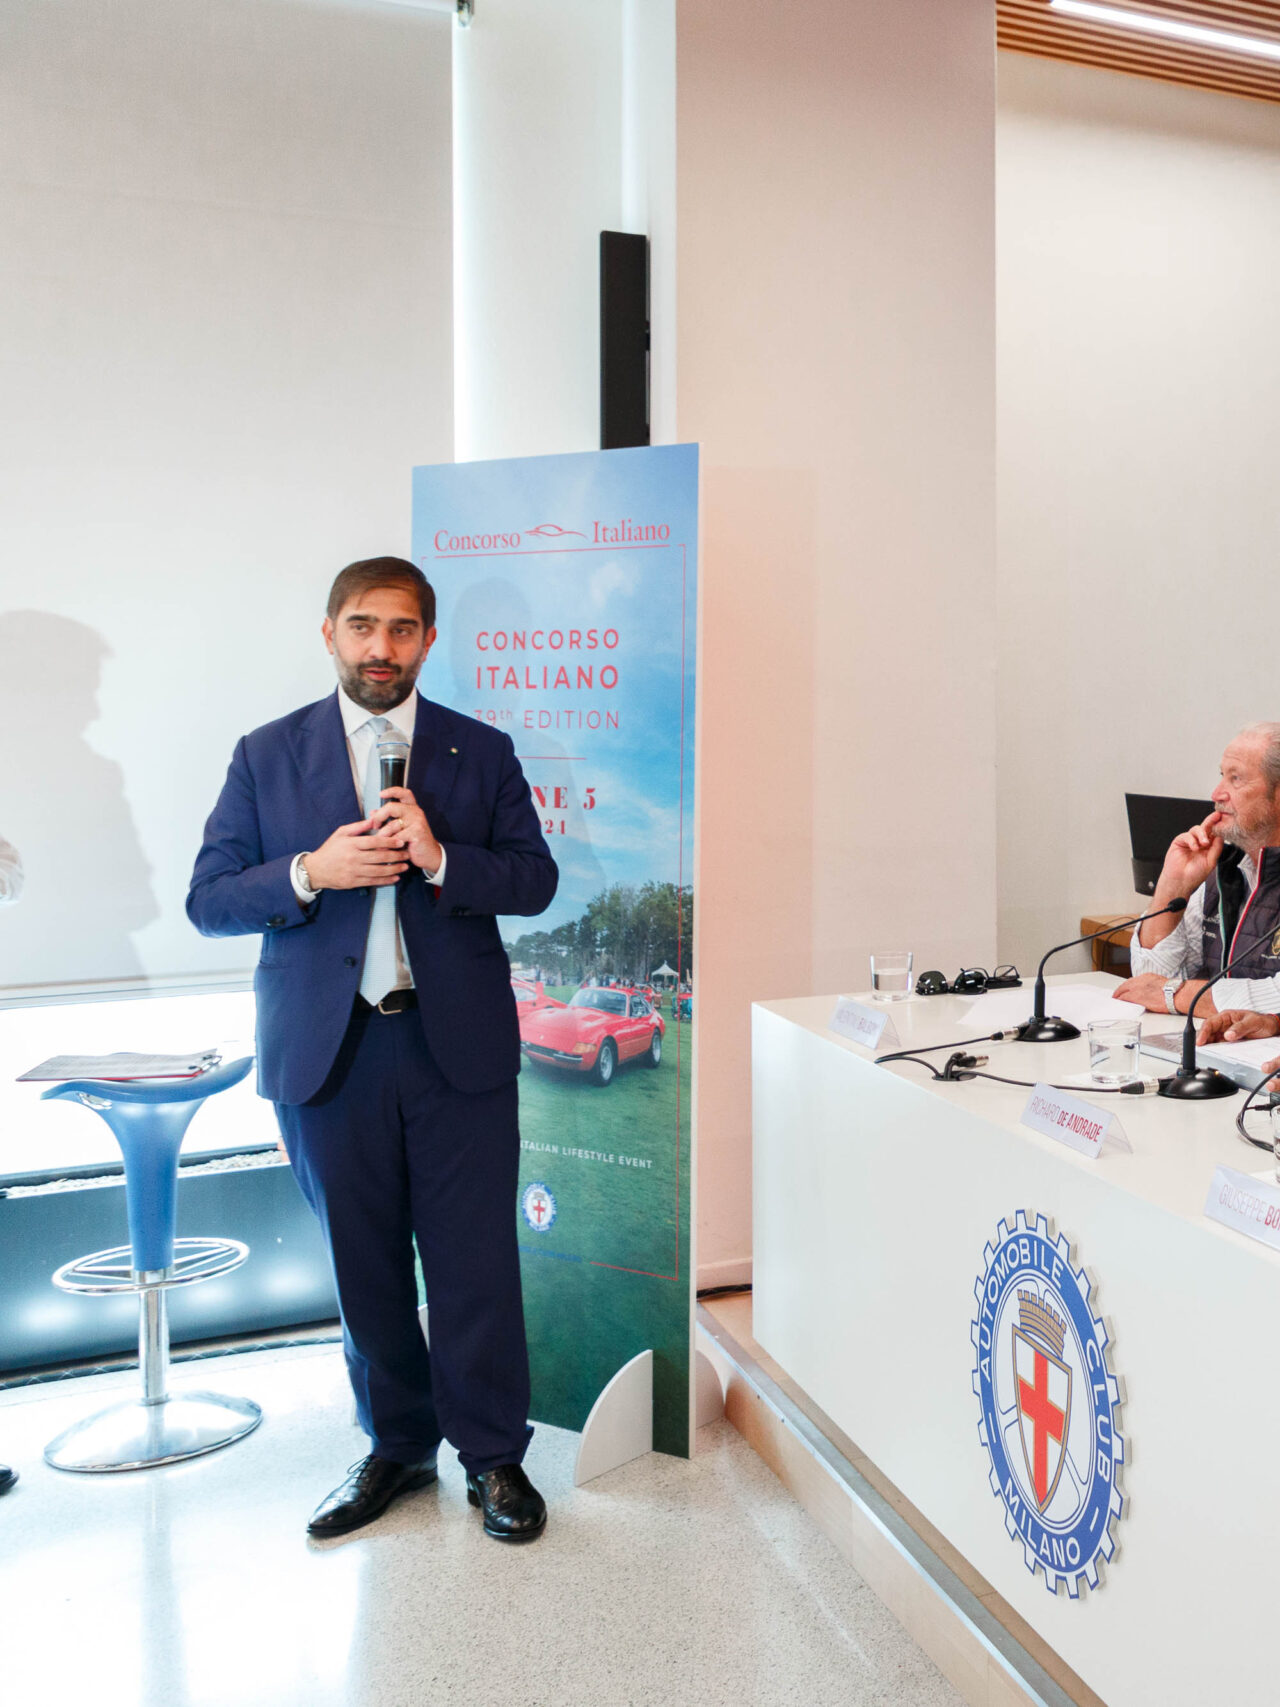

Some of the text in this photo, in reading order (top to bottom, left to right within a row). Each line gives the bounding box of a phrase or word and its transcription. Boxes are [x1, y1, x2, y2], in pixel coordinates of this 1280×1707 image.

[433, 518, 671, 552] Concorso Italiano
[476, 628, 620, 651] CONCORSO
[476, 664, 619, 690] ITALIANO
[523, 709, 620, 730] EDITION
[583, 787, 596, 811] 5
[1030, 1095, 1103, 1143] RICHARD DE ANDRADE
[520, 1140, 653, 1169] ITALIAN LIFESTYLE EVENT
[1219, 1183, 1268, 1223] GIUSEPPE
[980, 1237, 1112, 1484] AUTOMOBILE CLUB
[1004, 1476, 1081, 1567] MILANO
